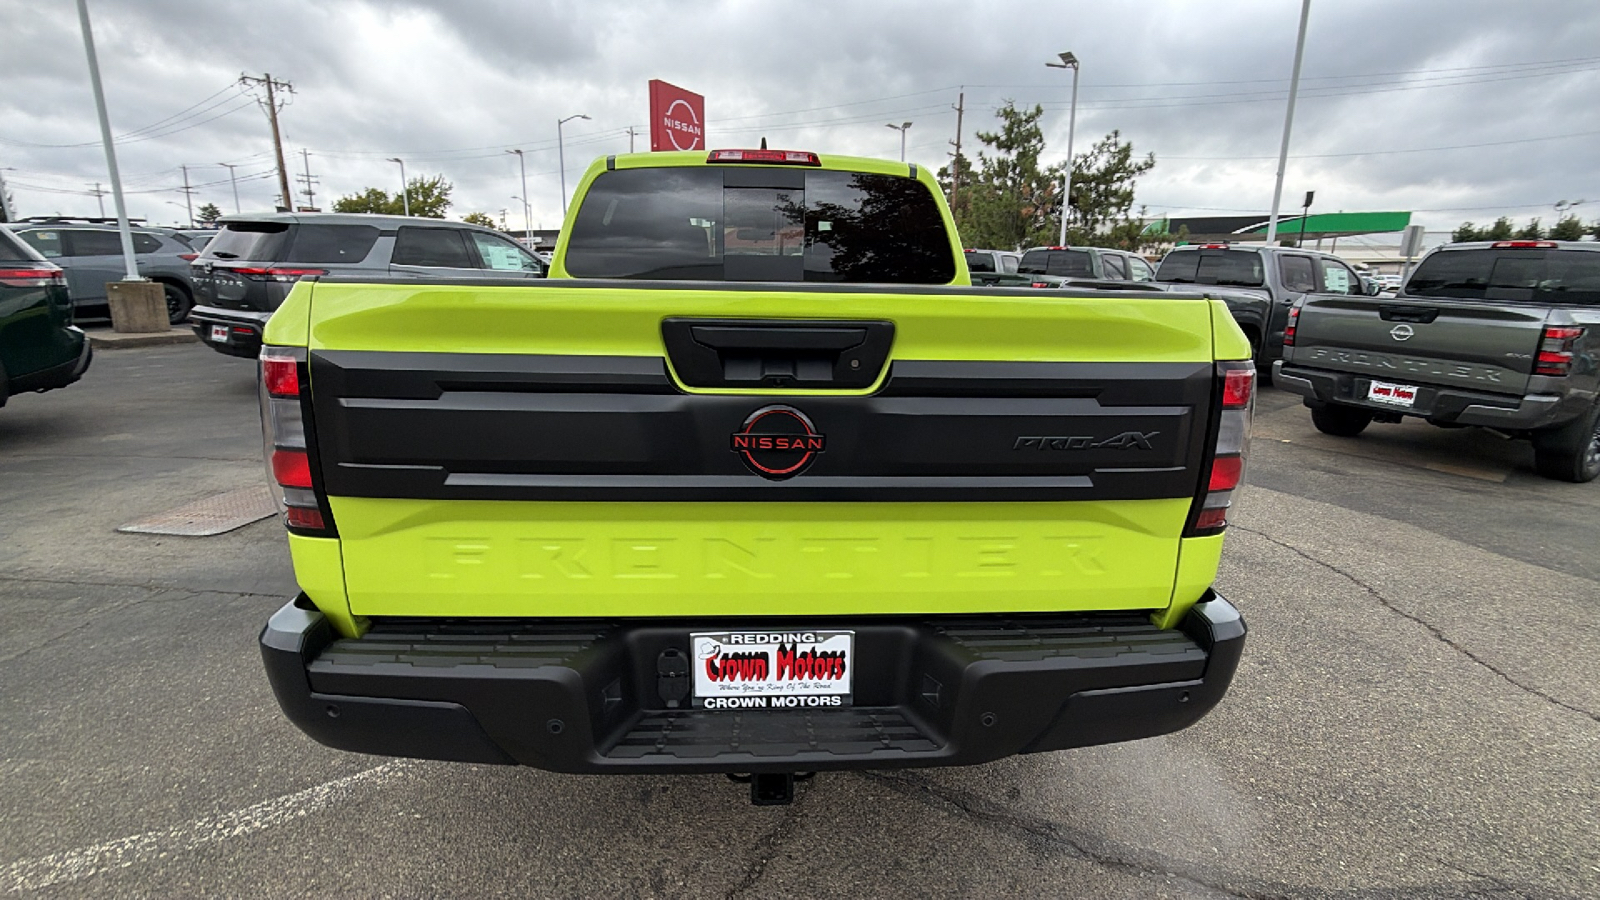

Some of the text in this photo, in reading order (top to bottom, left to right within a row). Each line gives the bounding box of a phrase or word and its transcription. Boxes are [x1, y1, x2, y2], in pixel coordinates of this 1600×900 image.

[664, 117, 701, 136] NISSAN
[1309, 347, 1503, 382] FRONTIER
[734, 436, 822, 449] NISSAN
[1012, 431, 1160, 450] PRO-4X
[422, 536, 1106, 578] FRONTIER
[730, 633, 816, 644] REDDING
[705, 643, 846, 682] Crown Motors
[704, 696, 842, 709] CROWN MOTORS
